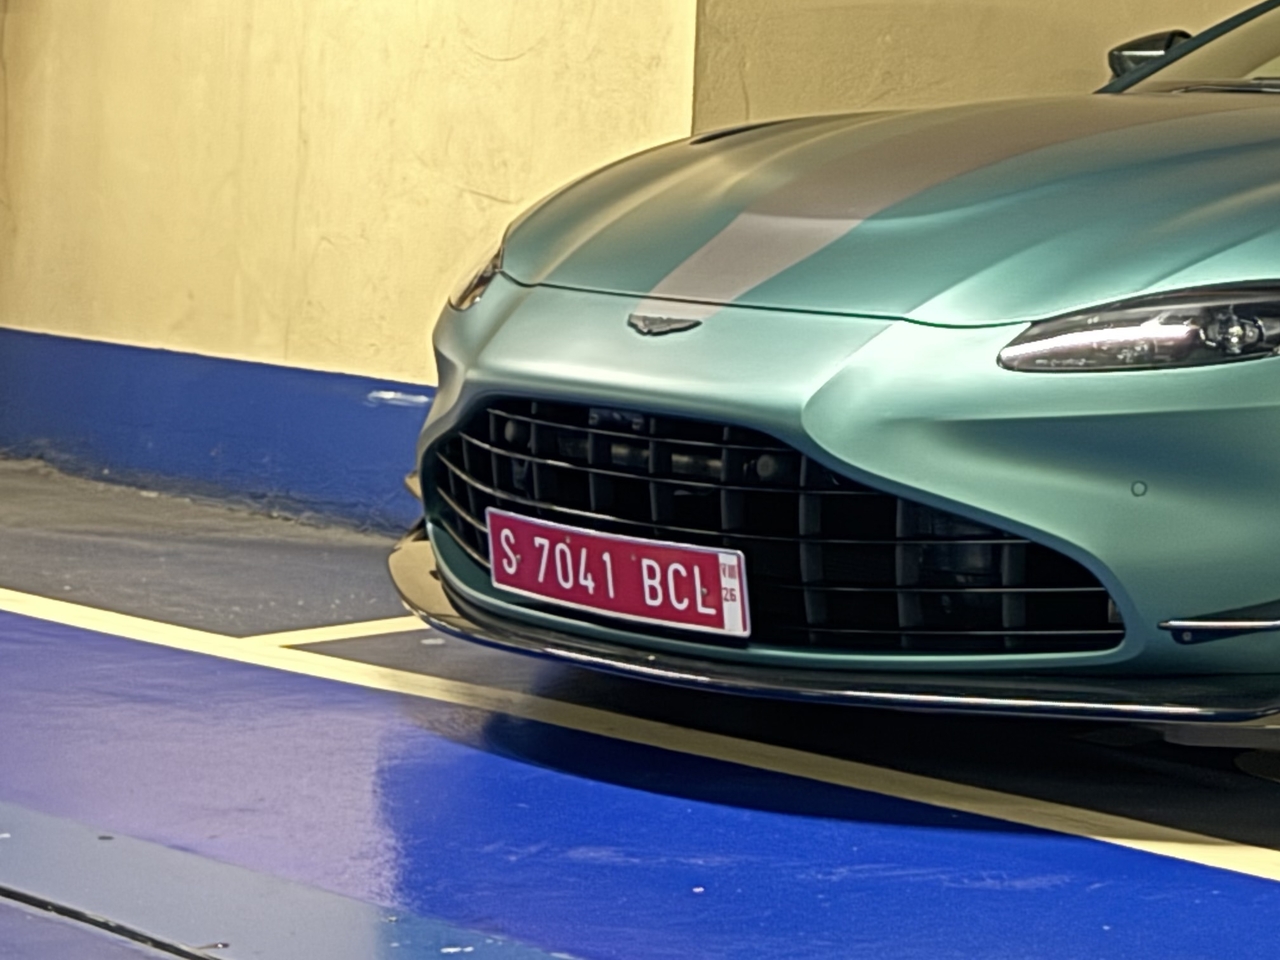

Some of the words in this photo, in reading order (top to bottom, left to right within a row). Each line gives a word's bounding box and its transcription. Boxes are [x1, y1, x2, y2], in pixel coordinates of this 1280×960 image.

[500, 528, 516, 575] S
[533, 536, 615, 599] 7041
[641, 557, 717, 615] BCL
[721, 586, 737, 602] 26
